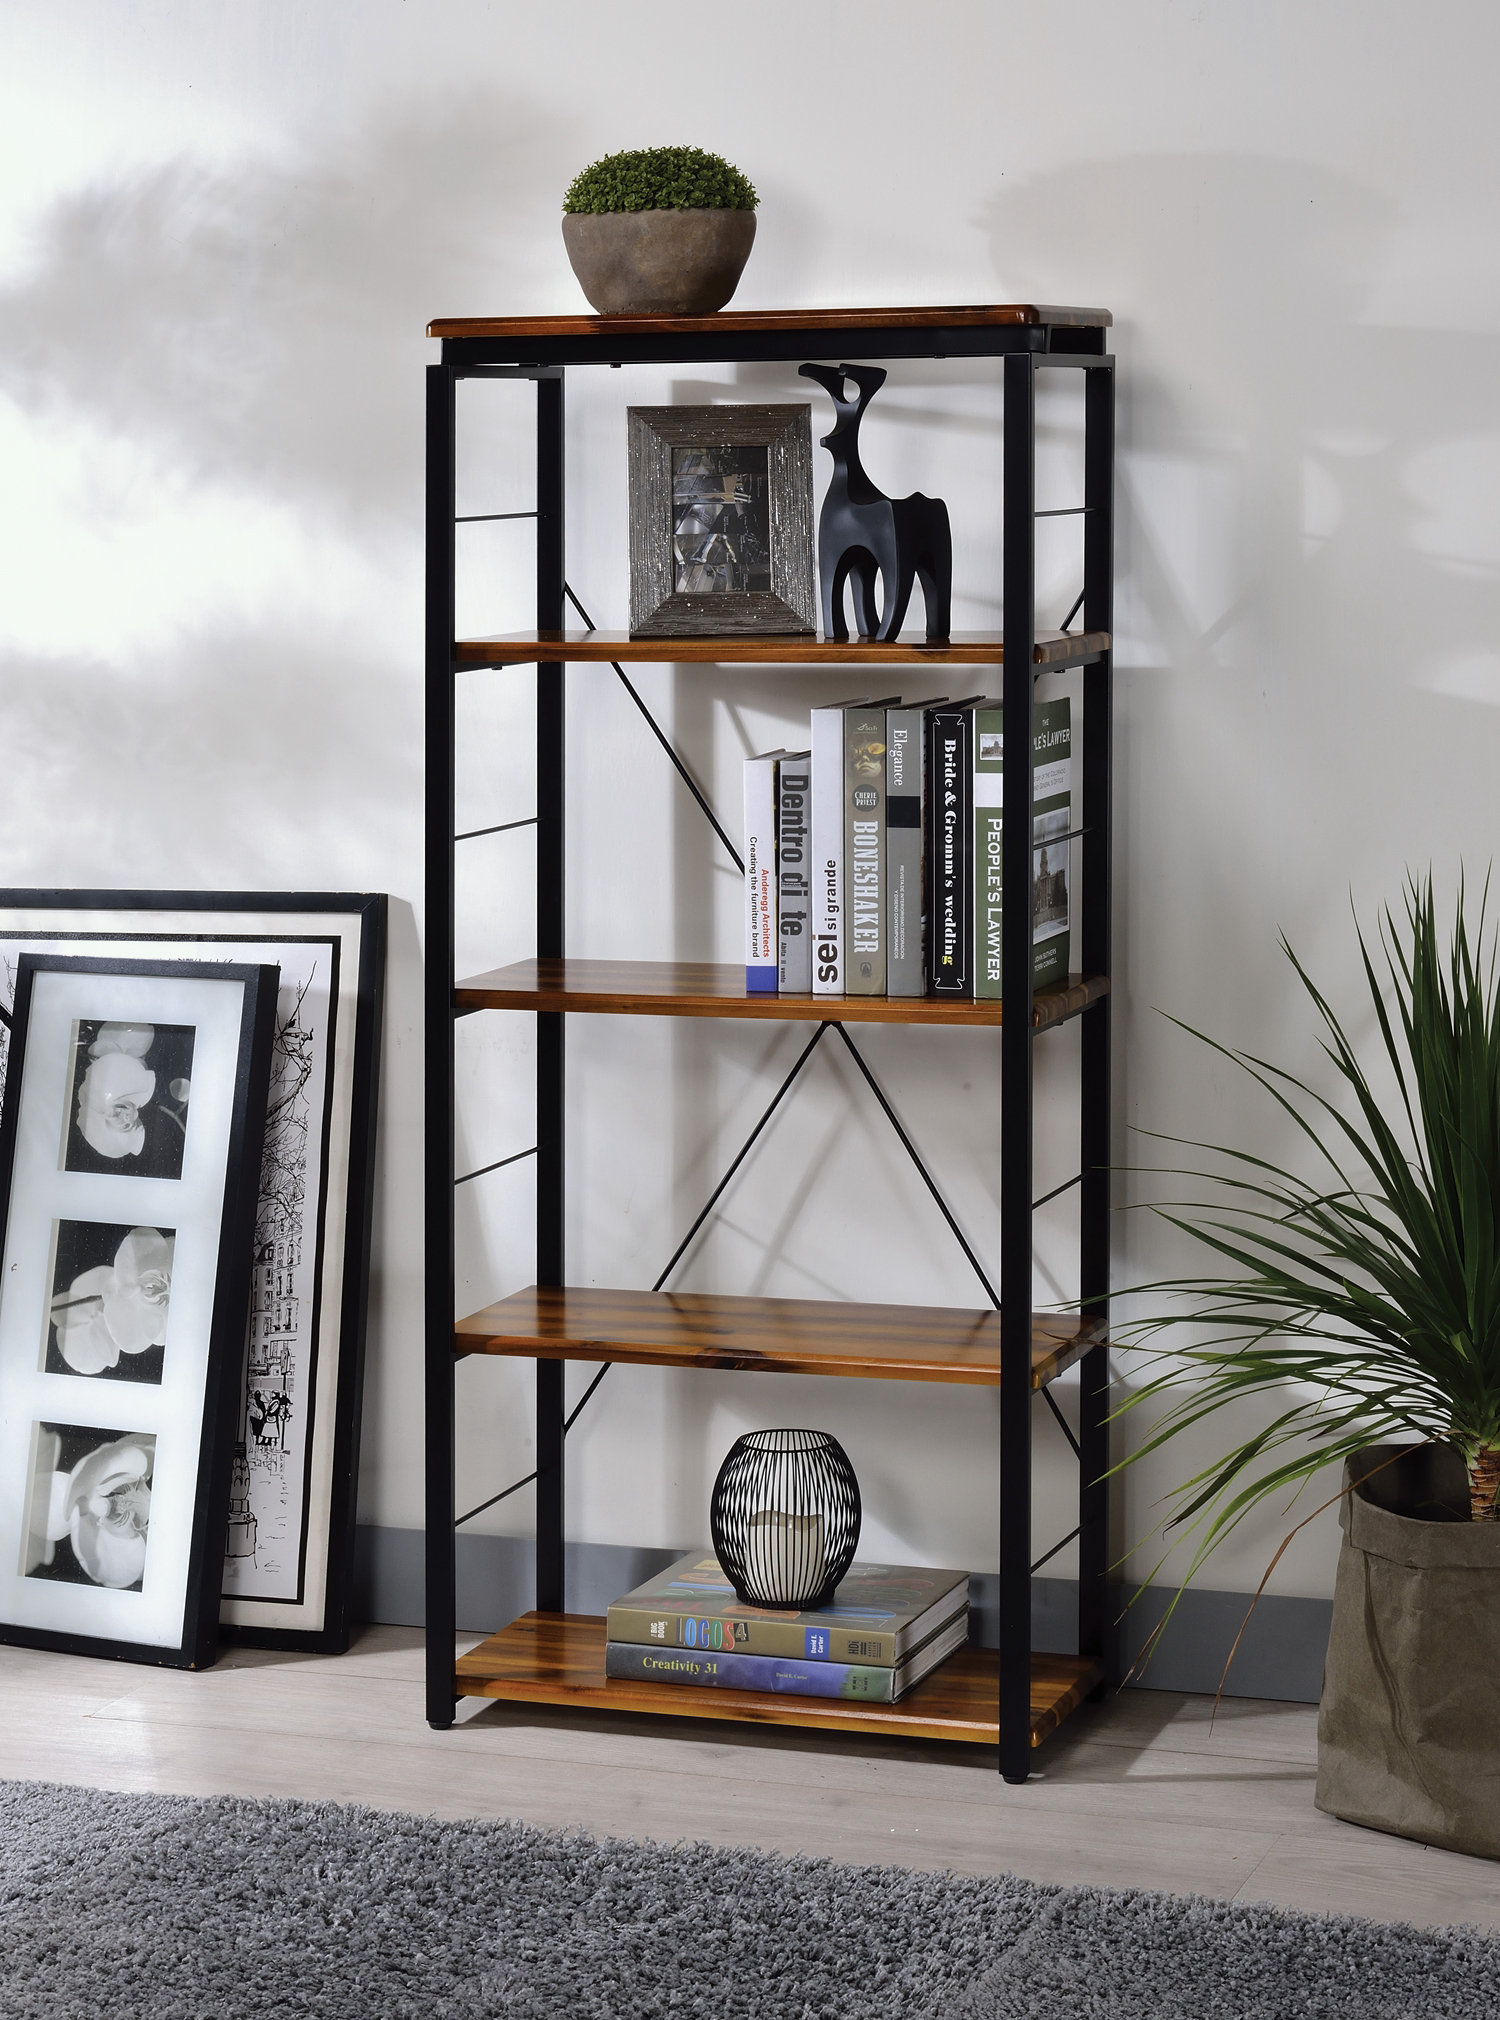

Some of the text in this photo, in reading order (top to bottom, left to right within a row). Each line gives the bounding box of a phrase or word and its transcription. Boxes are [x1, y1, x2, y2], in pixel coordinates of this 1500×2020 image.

[889, 729, 908, 786] Elegance
[1034, 728, 1071, 750] LE'S LAWYER
[854, 791, 877, 800] CHERIE
[856, 798, 876, 806] PRIEST
[749, 836, 758, 875] Creating
[780, 774, 809, 936] Dentro di te
[941, 739, 956, 965] Bride & Gromm's wedding
[853, 820, 879, 953] BONESHAKER
[987, 818, 1003, 981] PEOPLE'S LAWYER
[761, 868, 770, 958] Anderegg Architects
[812, 859, 840, 983] sei si grande
[752, 932, 760, 958] brand
[657, 1621, 665, 1639] BOOK
[676, 1617, 748, 1651] LOGOS 4
[642, 1656, 718, 1675] Creativity 31
